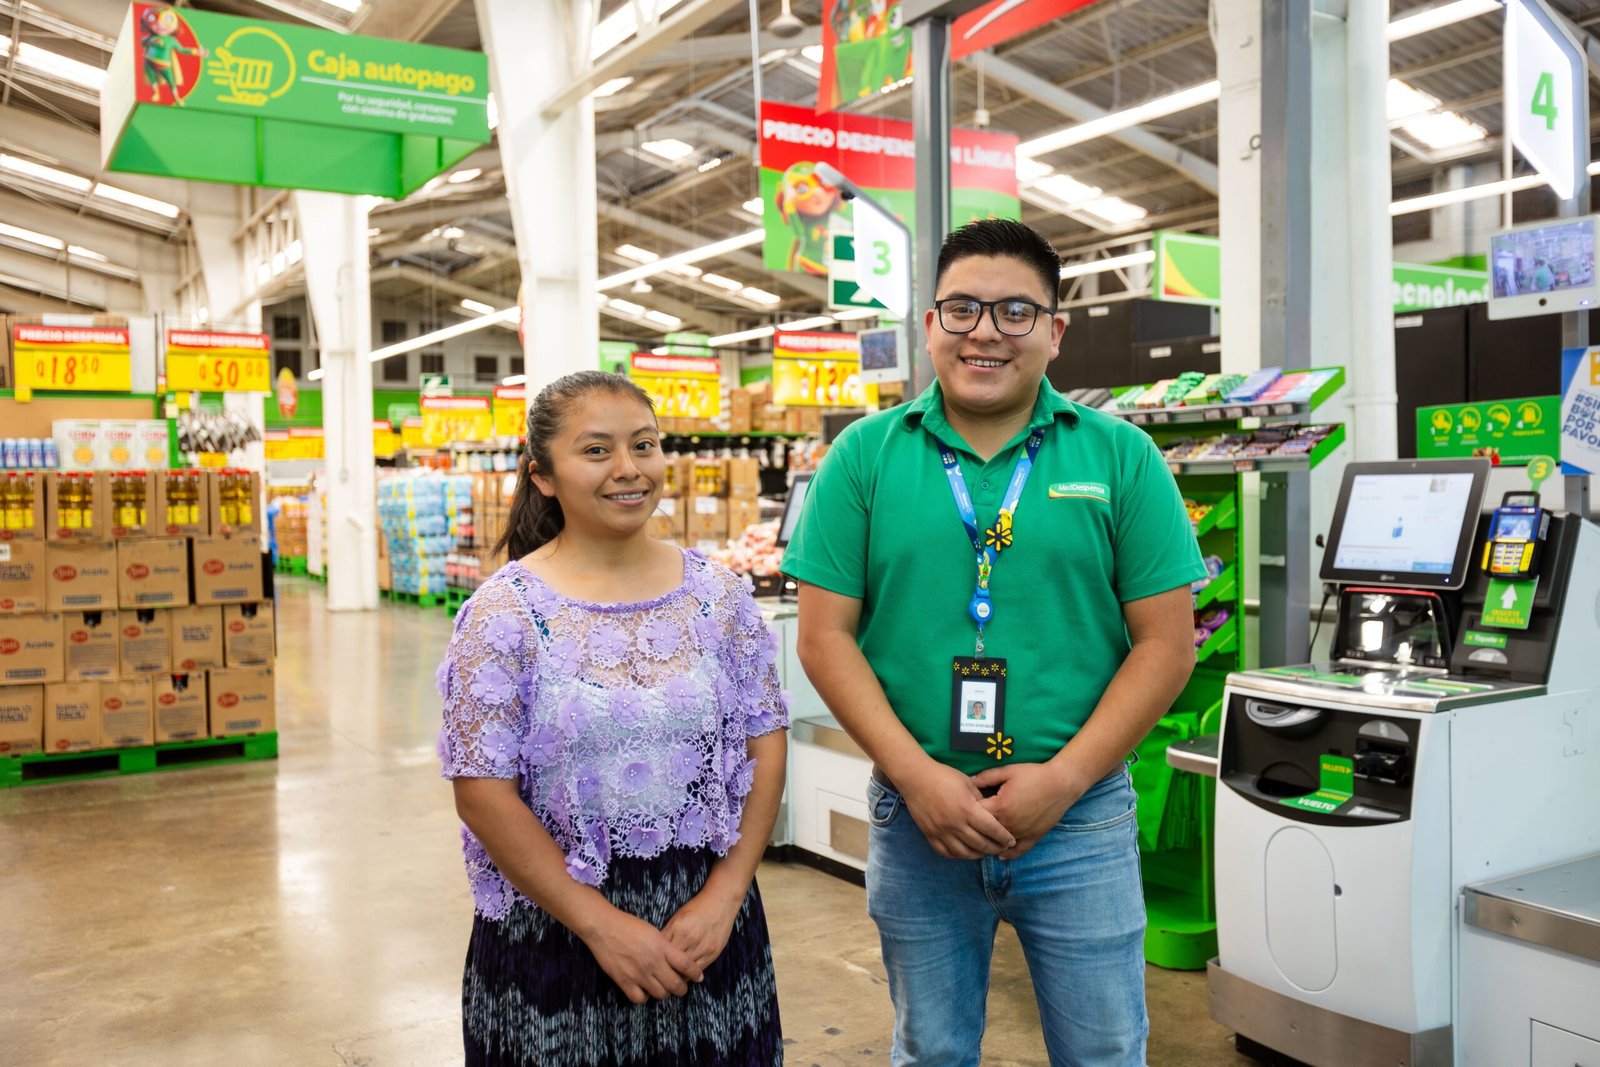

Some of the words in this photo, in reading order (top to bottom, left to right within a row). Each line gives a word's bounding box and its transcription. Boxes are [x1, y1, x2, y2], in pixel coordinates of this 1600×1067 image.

[307, 49, 360, 81] Caja
[364, 61, 476, 96] autopago
[1531, 71, 1558, 131] 4
[762, 119, 836, 149] PRECIO
[871, 240, 892, 276] 3
[1566, 414, 1595, 433] POR
[1533, 462, 1548, 479] 3
[1297, 797, 1337, 811] VUELTO
